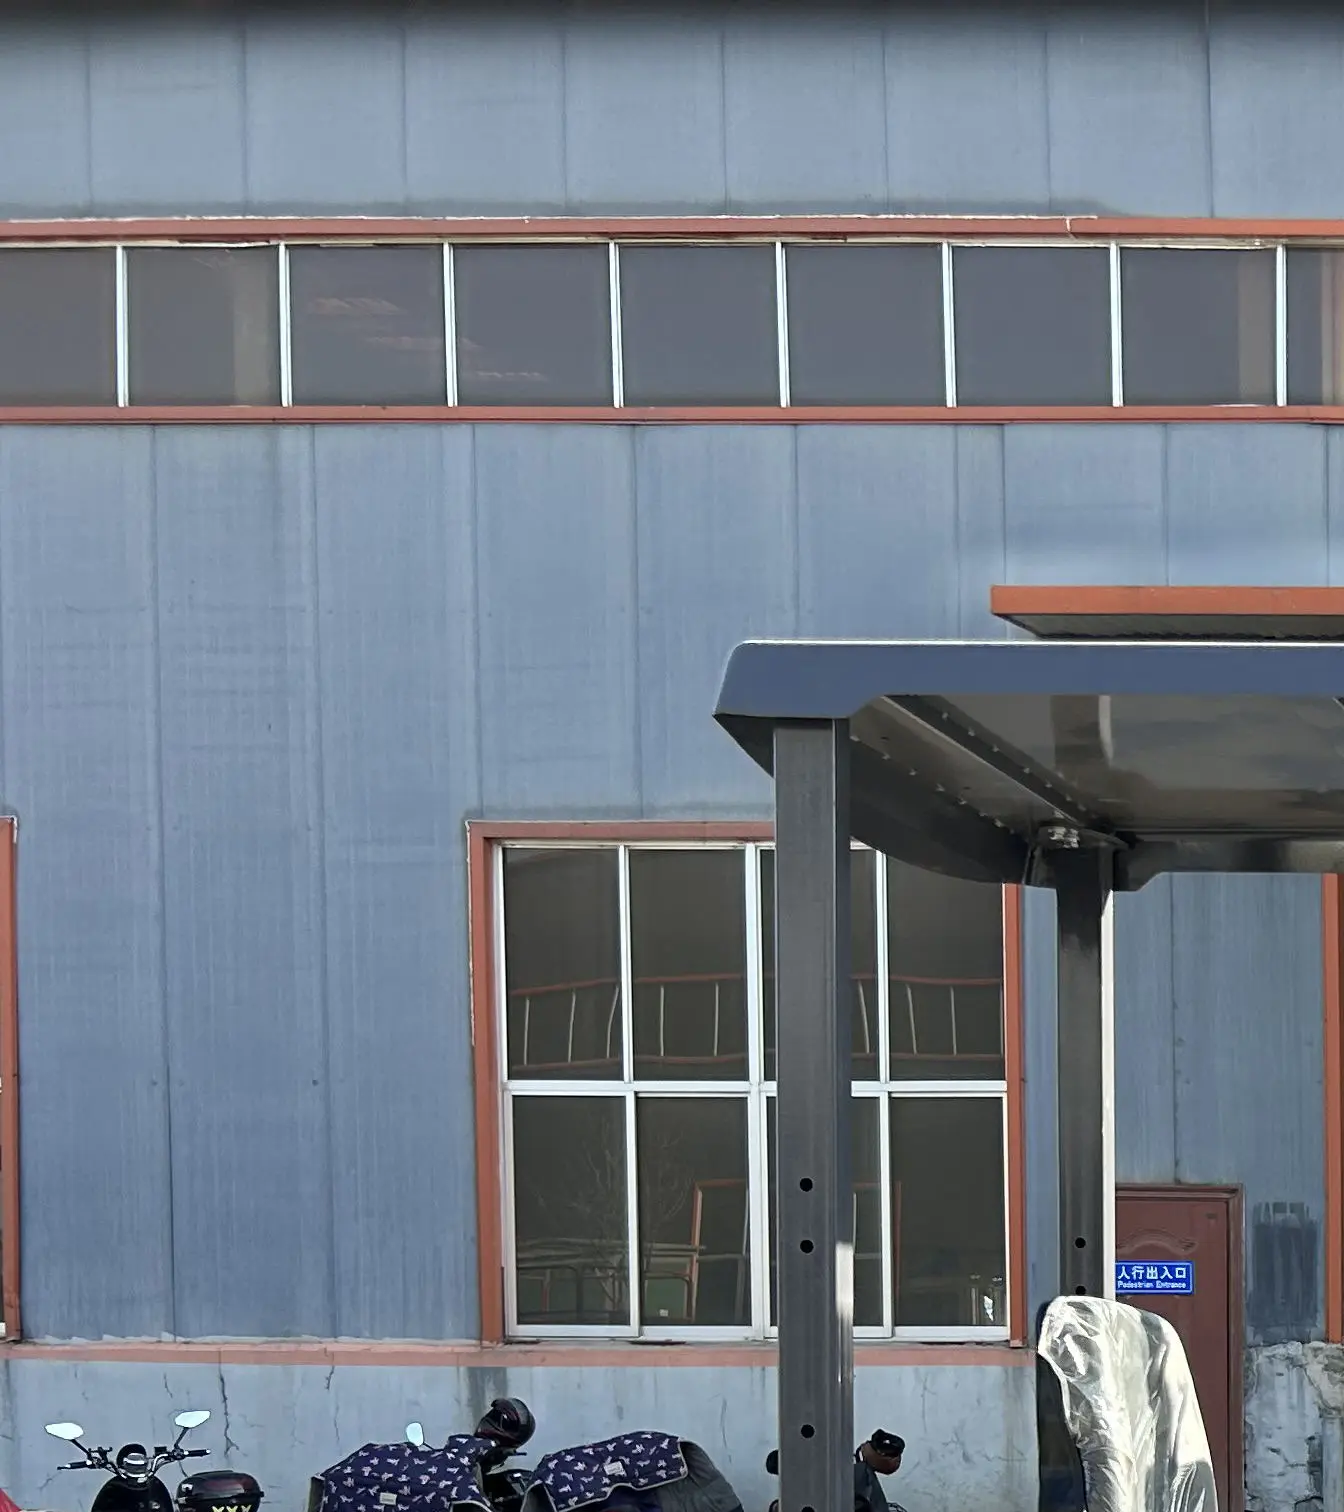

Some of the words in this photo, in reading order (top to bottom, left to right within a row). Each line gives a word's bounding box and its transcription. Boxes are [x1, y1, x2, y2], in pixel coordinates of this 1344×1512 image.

[1118, 1266, 1187, 1280] 人行出入口
[1156, 1281, 1187, 1289] Entrance
